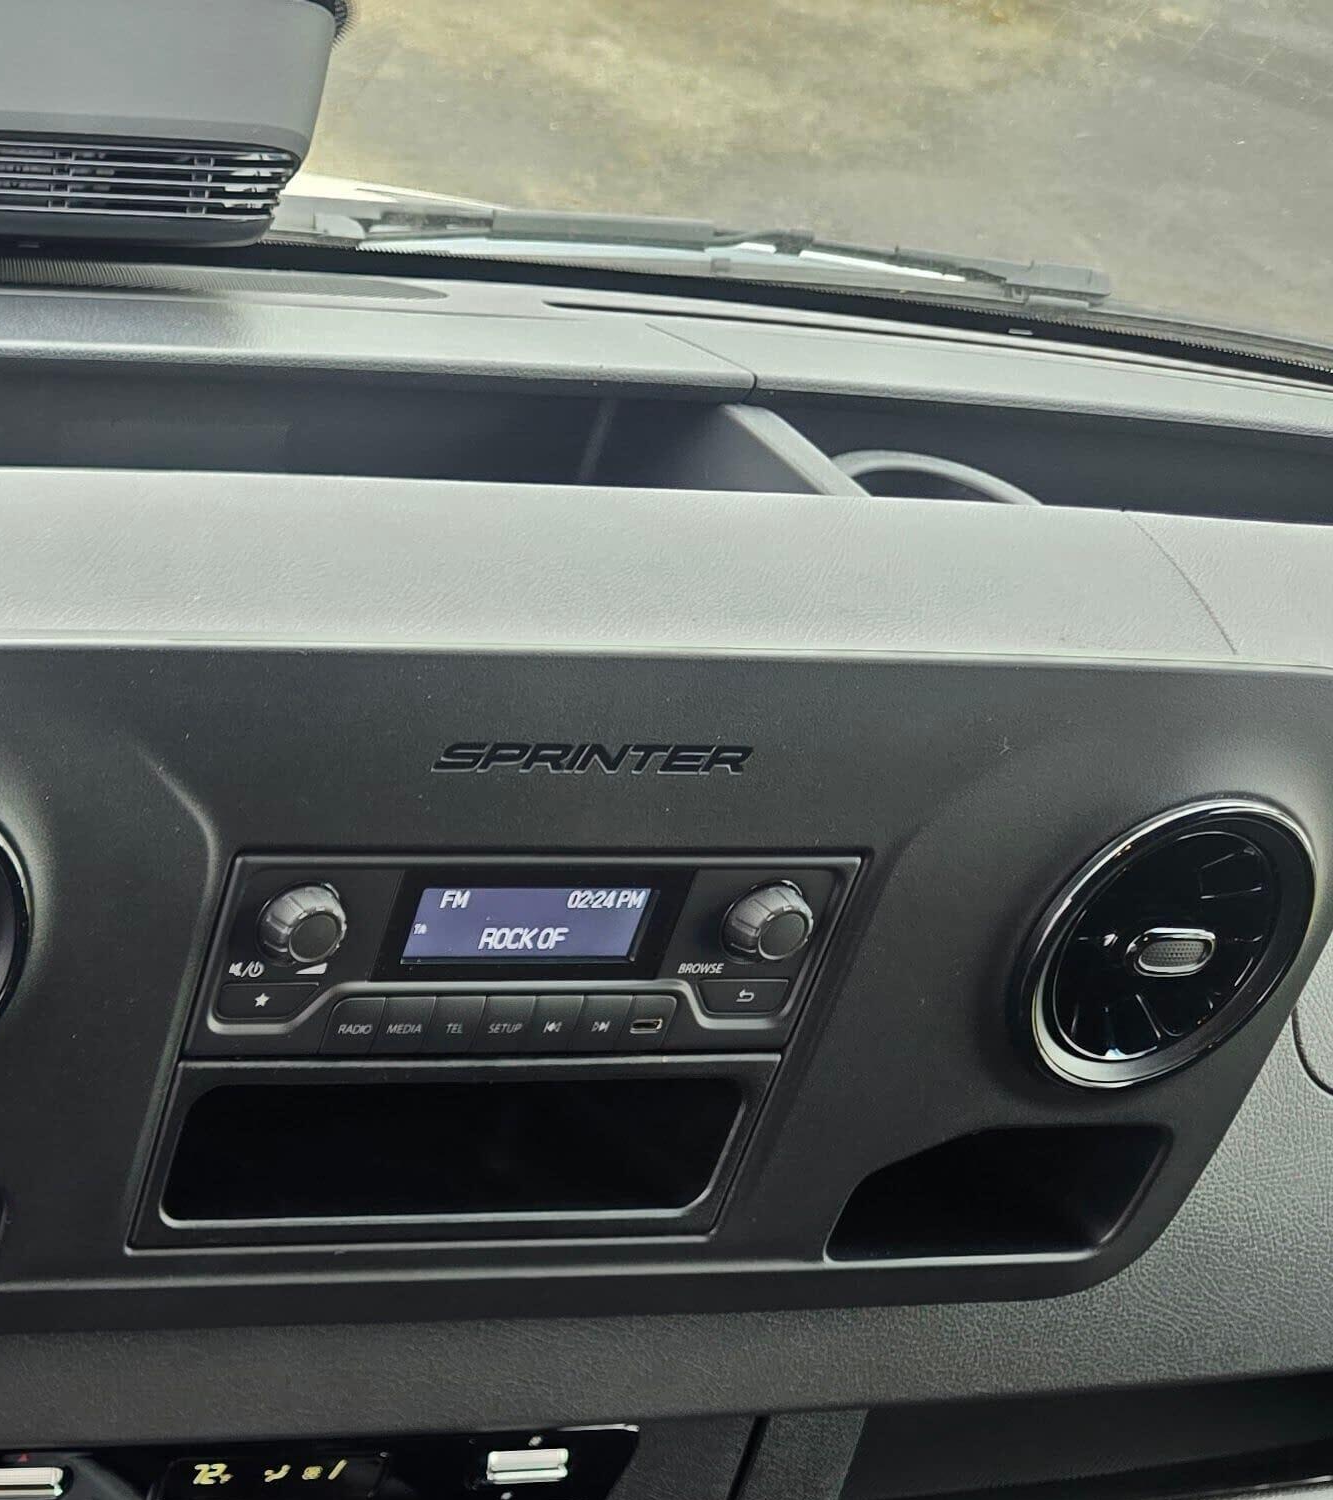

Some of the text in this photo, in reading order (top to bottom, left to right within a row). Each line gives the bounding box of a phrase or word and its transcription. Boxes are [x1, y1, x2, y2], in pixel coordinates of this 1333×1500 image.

[431, 742, 754, 774] SPRINTER
[439, 890, 647, 909] FM 02:24 PM
[478, 927, 570, 950] ROCK OF
[677, 962, 724, 974] BROWSE
[337, 1023, 373, 1035] RADIO
[385, 1023, 422, 1035] MEDIA
[446, 1023, 463, 1034] TEL
[487, 1023, 523, 1034] SETUP
